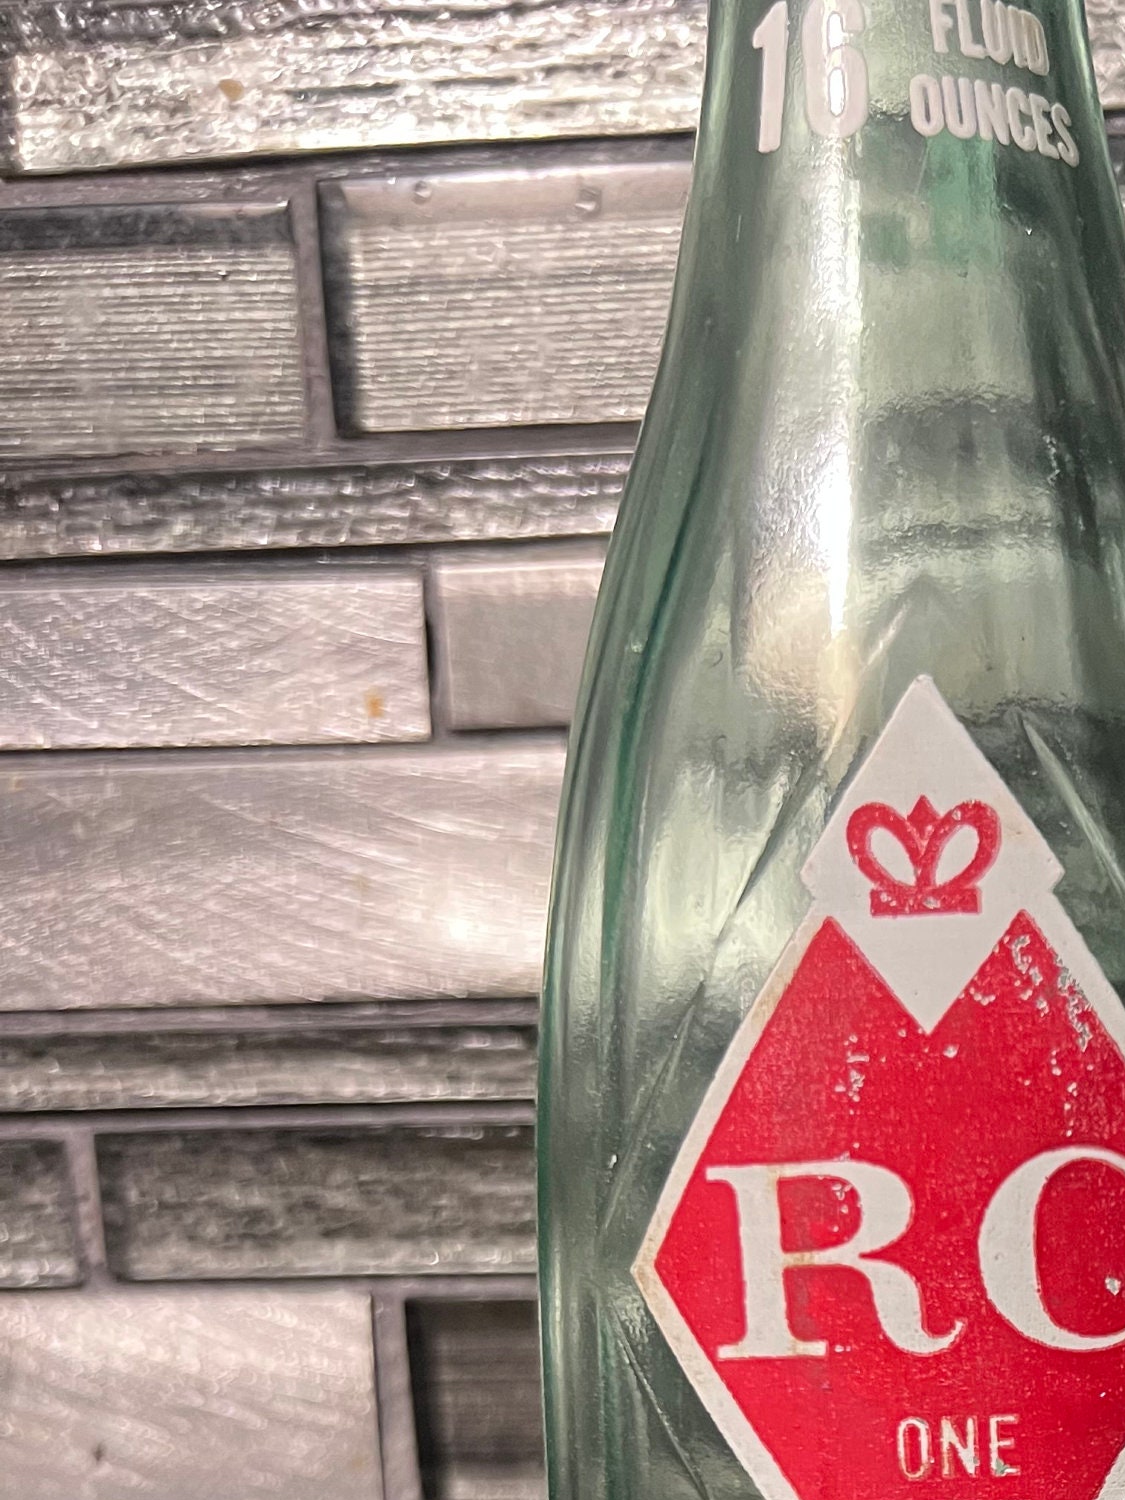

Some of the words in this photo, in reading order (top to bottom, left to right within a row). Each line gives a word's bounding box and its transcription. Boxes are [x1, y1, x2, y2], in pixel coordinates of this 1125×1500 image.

[752, 0, 870, 154] 16
[928, 0, 1050, 76] FLUID
[909, 73, 1080, 168] OUNCES
[896, 1413, 1020, 1480] ONE
